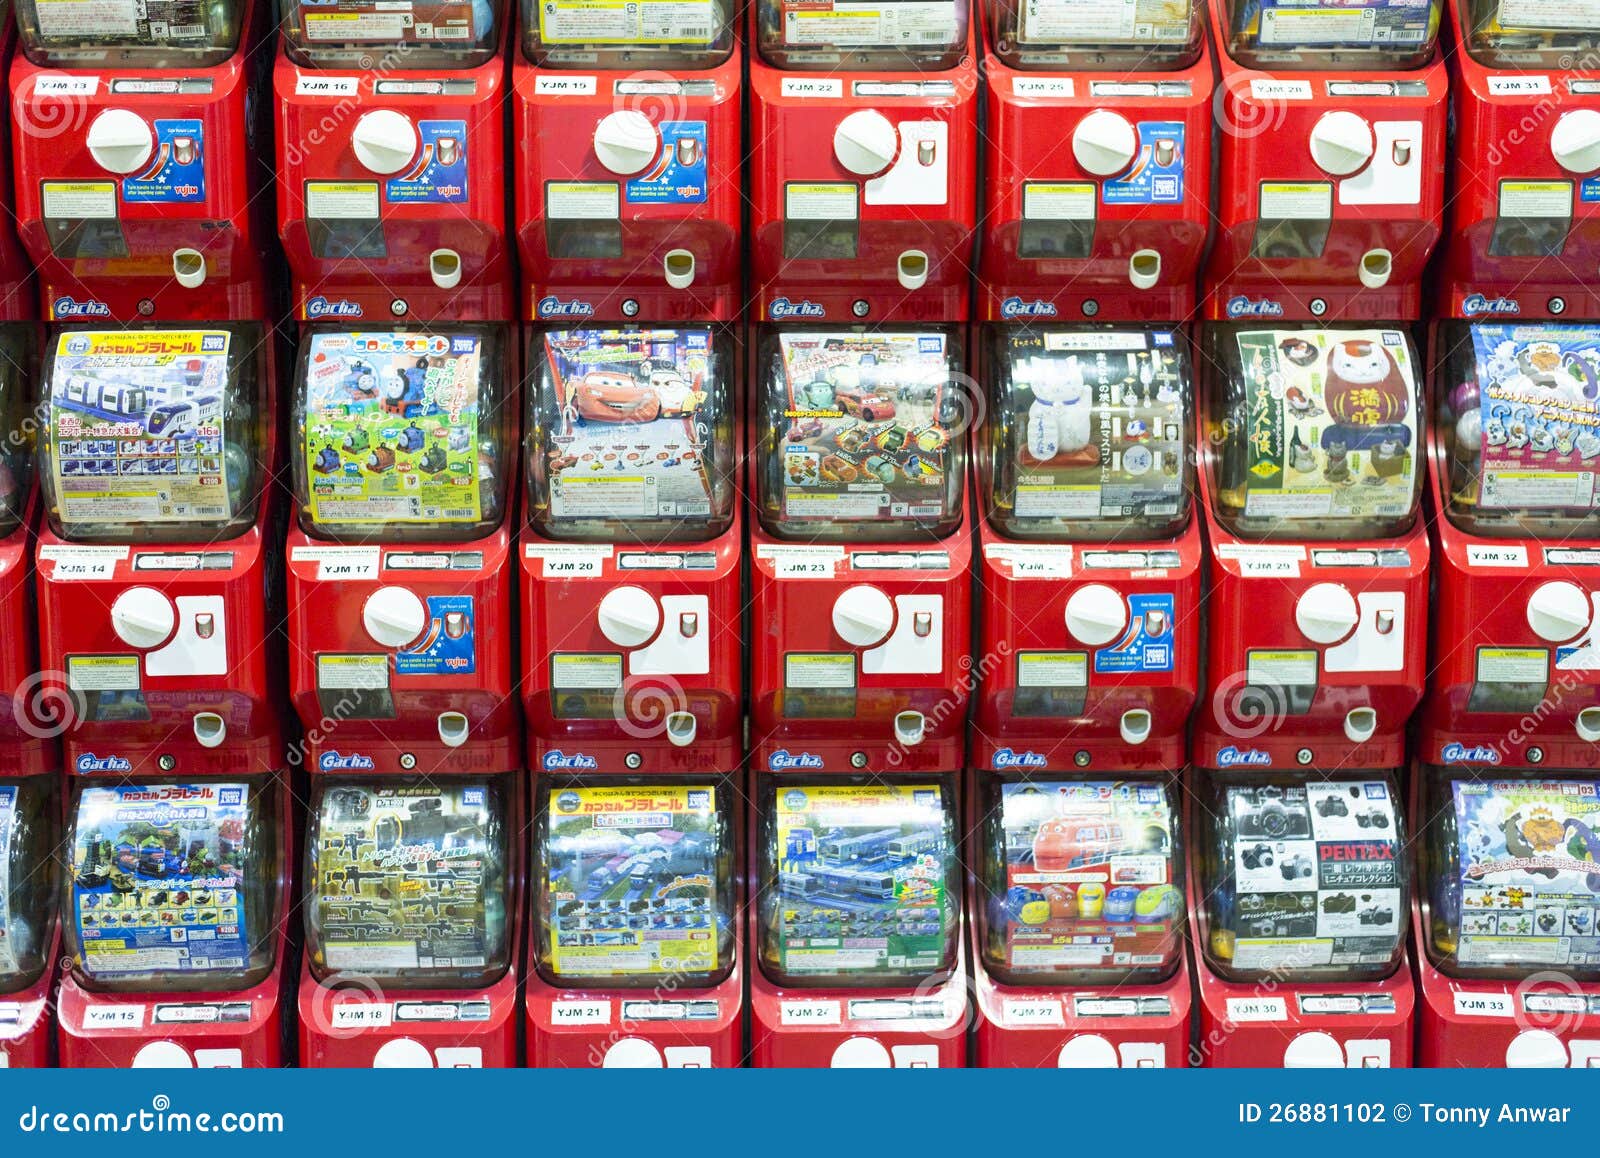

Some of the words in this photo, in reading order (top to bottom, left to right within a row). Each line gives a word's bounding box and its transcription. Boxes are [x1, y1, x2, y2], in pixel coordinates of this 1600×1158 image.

[302, 82, 329, 90] YJM
[1494, 82, 1521, 90] YJM
[1473, 553, 1499, 561] YJM
[1503, 553, 1517, 561] 32
[60, 565, 86, 573] YJM
[91, 565, 105, 573] 14
[324, 565, 351, 574] YJM
[356, 565, 370, 573] 17
[548, 562, 575, 571] YJM
[578, 562, 594, 571] 20
[783, 564, 807, 572] JM
[811, 564, 825, 572] 23
[1581, 784, 1593, 794] 03
[123, 788, 214, 801] カプセルプラレール
[1320, 845, 1393, 861] PENTAX
[1236, 1005, 1259, 1013] YJM
[1263, 1004, 1277, 1013] 30
[1459, 1000, 1486, 1009] YJM
[1489, 1001, 1504, 1010] 33
[120, 1012, 135, 1020] 15
[369, 1010, 382, 1019] 18
[557, 1008, 583, 1017] YJM
[586, 1008, 600, 1017] 21
[787, 1008, 813, 1017] YJM
[1039, 1008, 1052, 1016] 27
